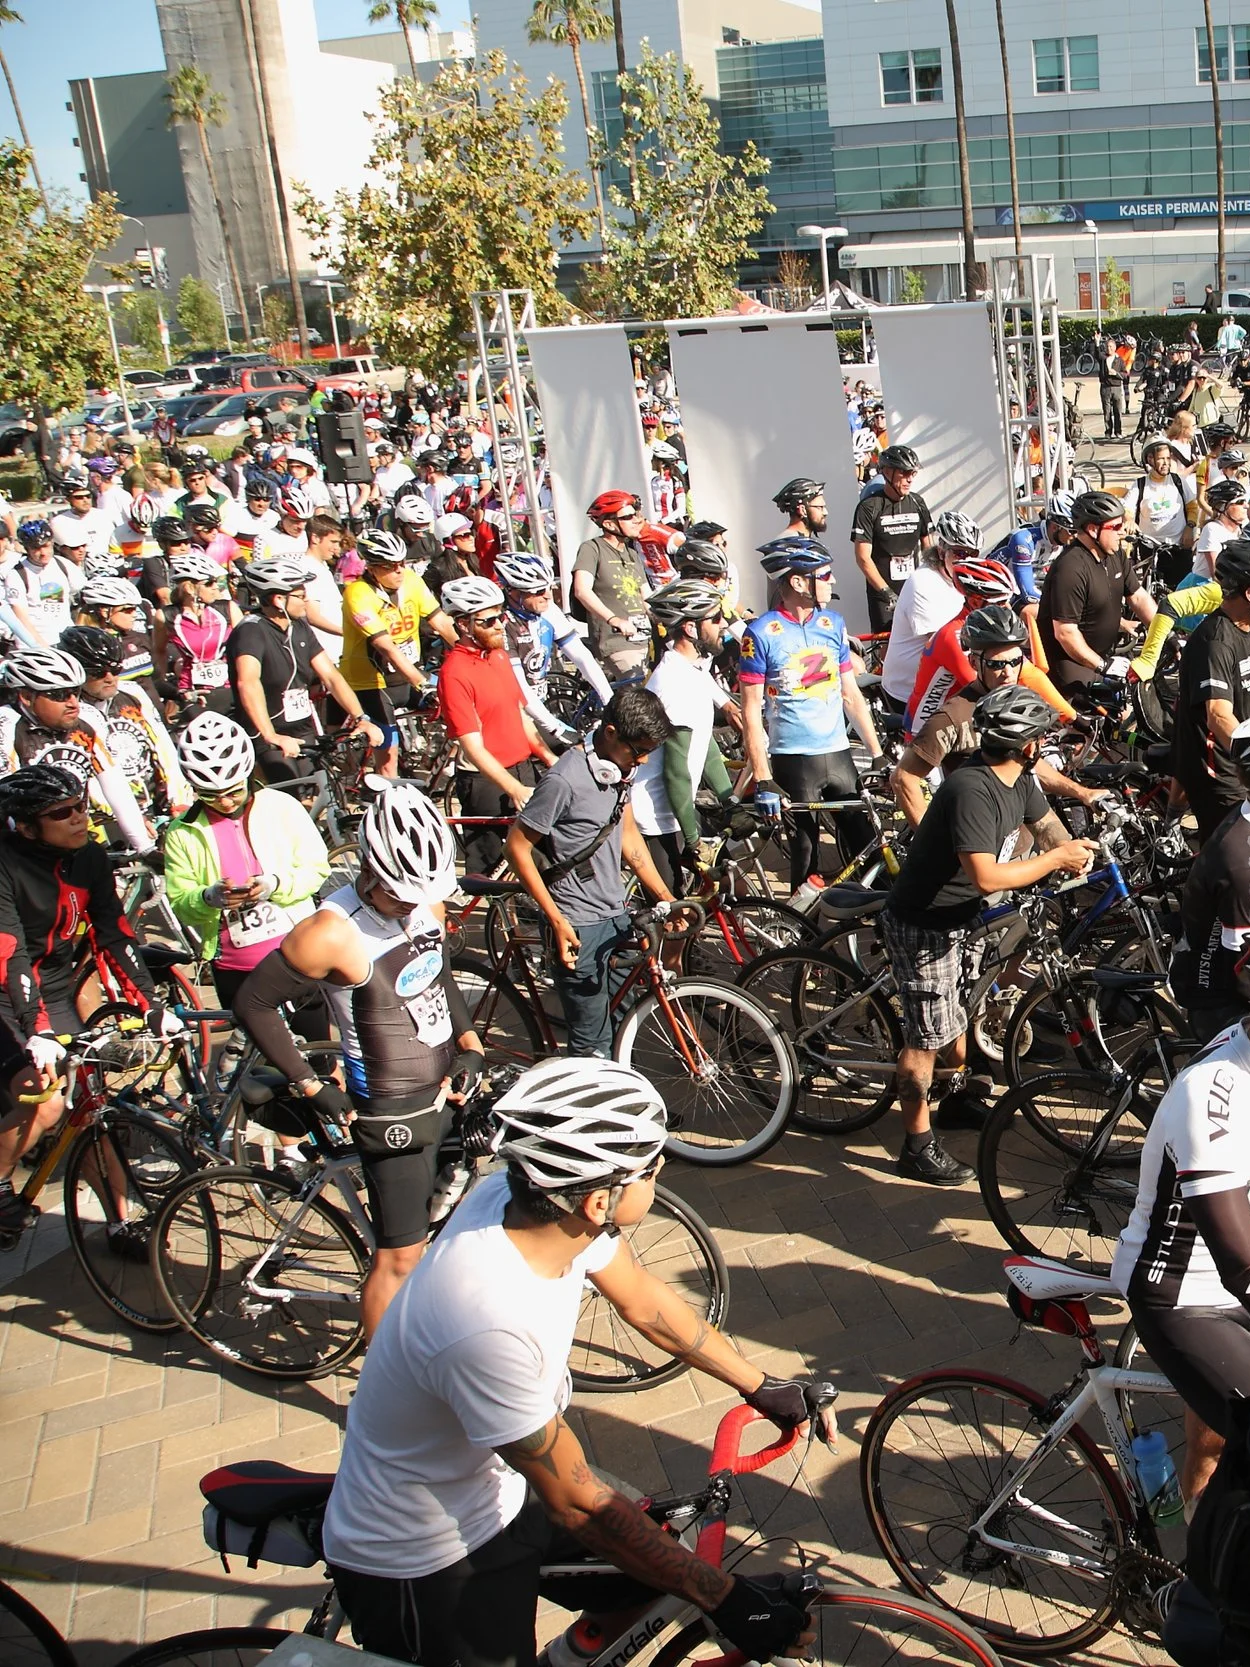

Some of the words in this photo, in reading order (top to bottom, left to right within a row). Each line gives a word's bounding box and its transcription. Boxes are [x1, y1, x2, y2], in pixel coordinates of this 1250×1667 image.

[1119, 203, 1163, 216] KAISER
[799, 652, 832, 690] Z
[919, 673, 955, 722] ARMENIA
[240, 904, 277, 932] 132
[1102, 1411, 1132, 1465] COLNAGO
